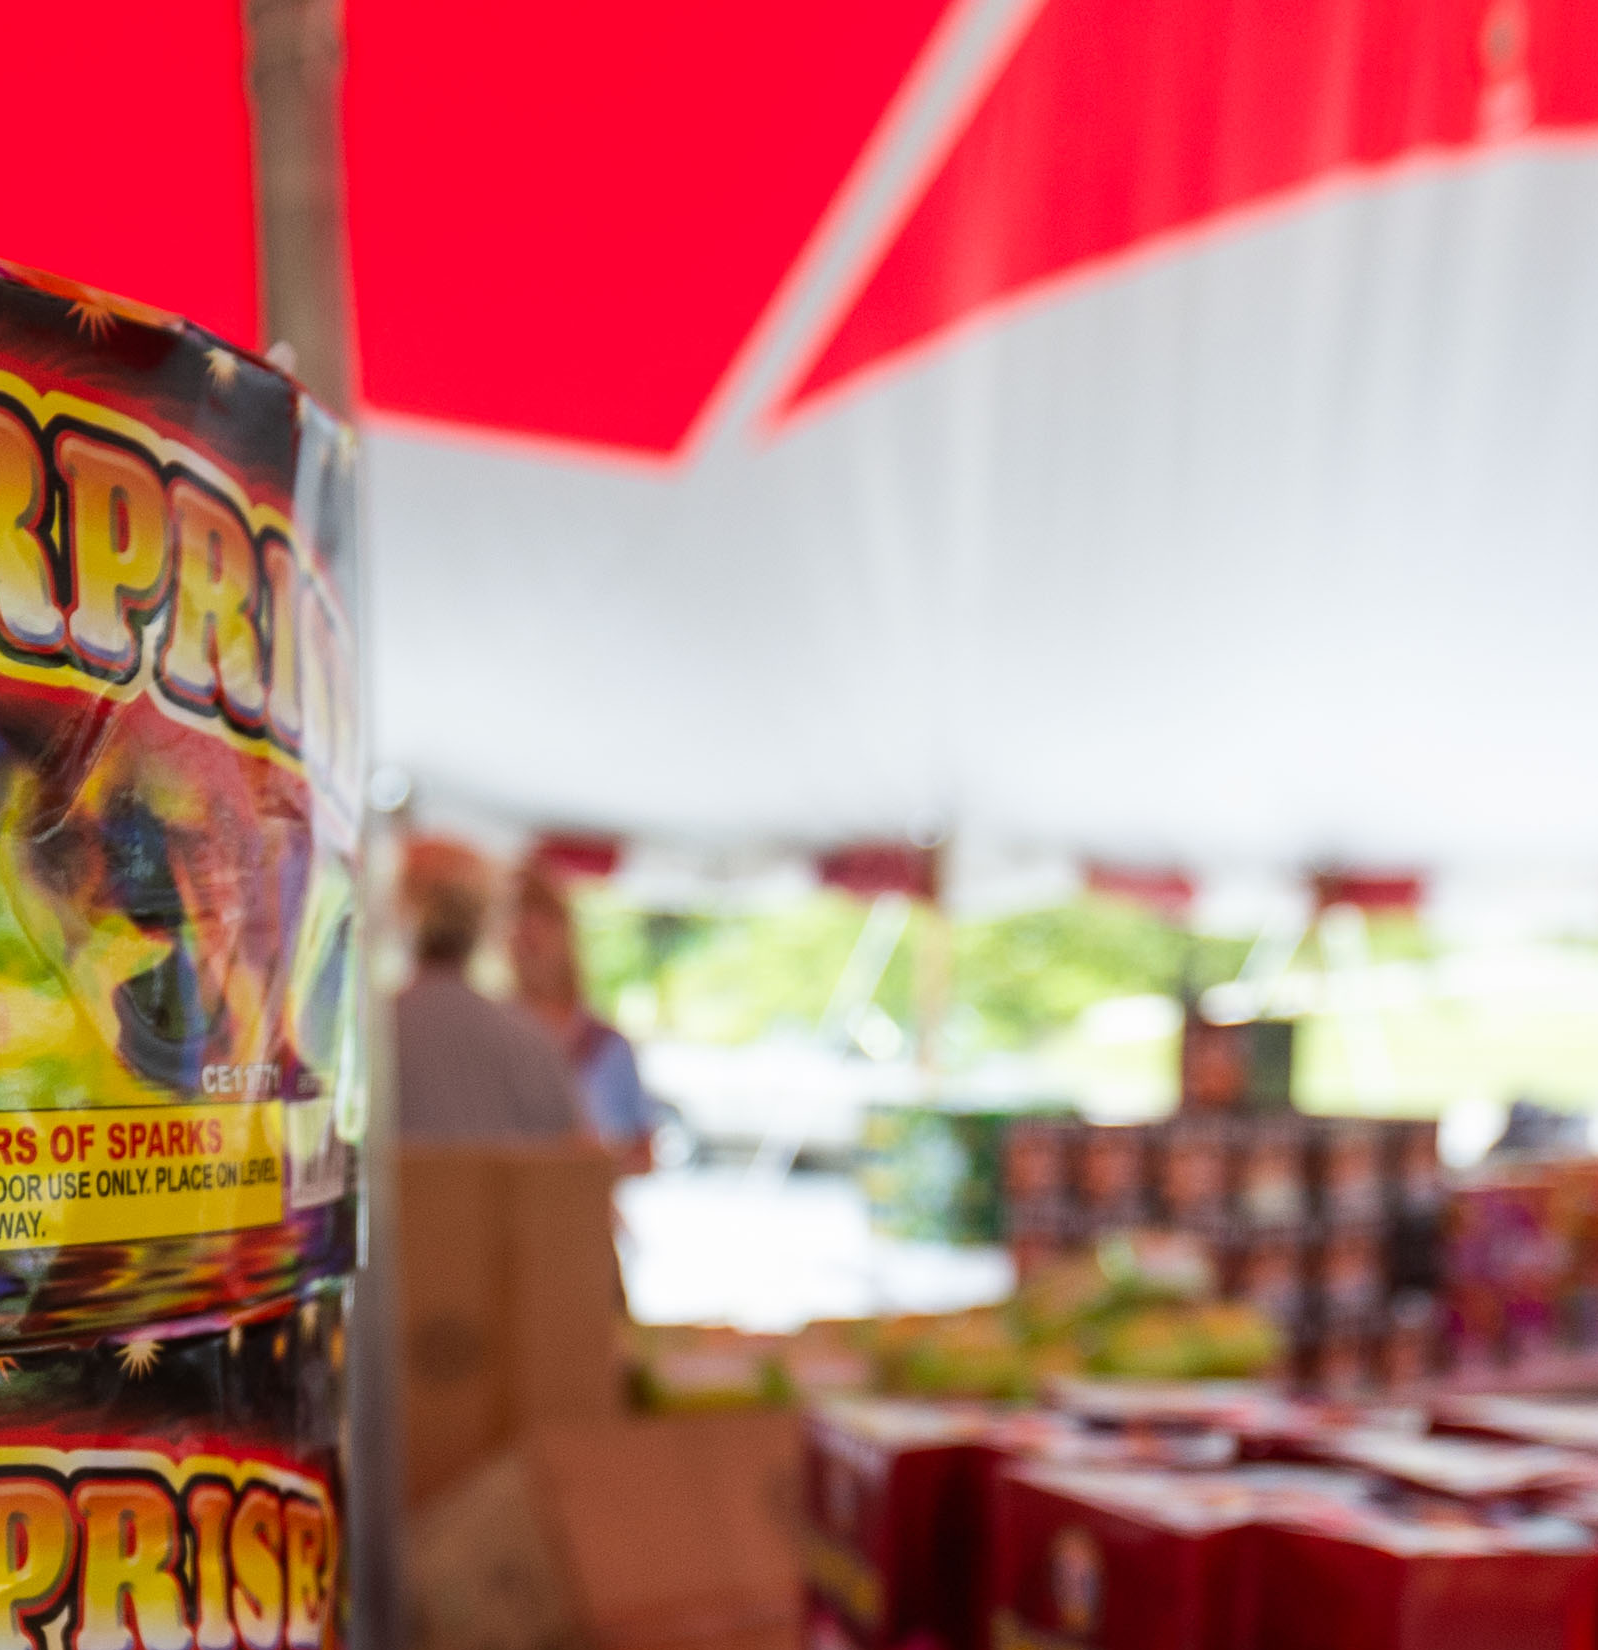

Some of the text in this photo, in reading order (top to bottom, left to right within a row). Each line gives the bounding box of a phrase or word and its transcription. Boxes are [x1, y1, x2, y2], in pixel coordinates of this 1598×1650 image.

[50, 1124, 95, 1164] OF
[107, 1118, 223, 1161] SPARKS
[48, 1170, 91, 1200] USE
[96, 1166, 151, 1198] ONLY.
[155, 1162, 212, 1194] PLACE
[216, 1162, 237, 1188] ON
[239, 1157, 278, 1187] LEVEL
